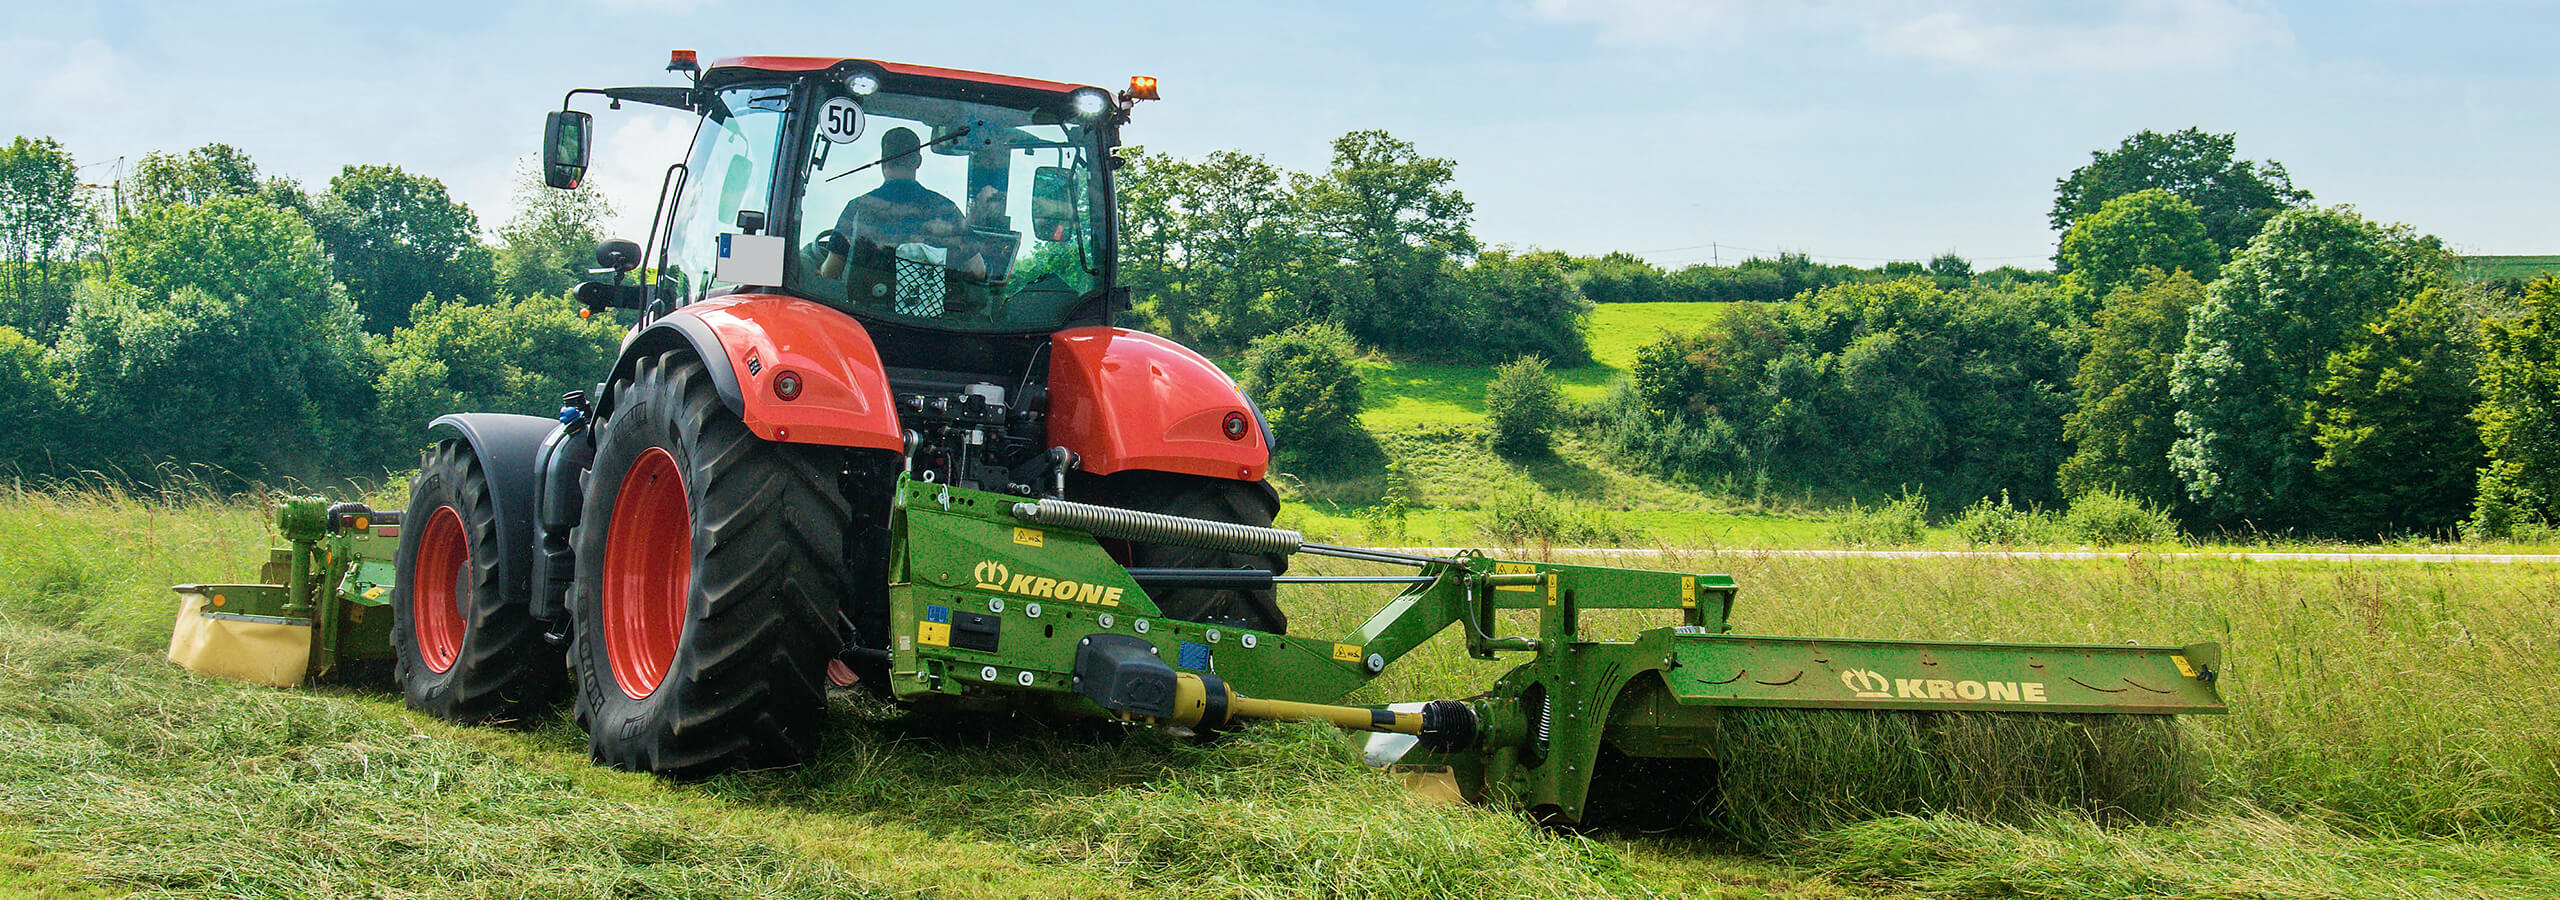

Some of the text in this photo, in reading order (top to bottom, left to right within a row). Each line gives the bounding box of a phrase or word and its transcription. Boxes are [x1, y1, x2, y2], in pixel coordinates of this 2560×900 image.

[828, 105, 856, 136] 50
[1007, 573, 1124, 607] KRONE
[1894, 678, 2048, 702] KRONE
